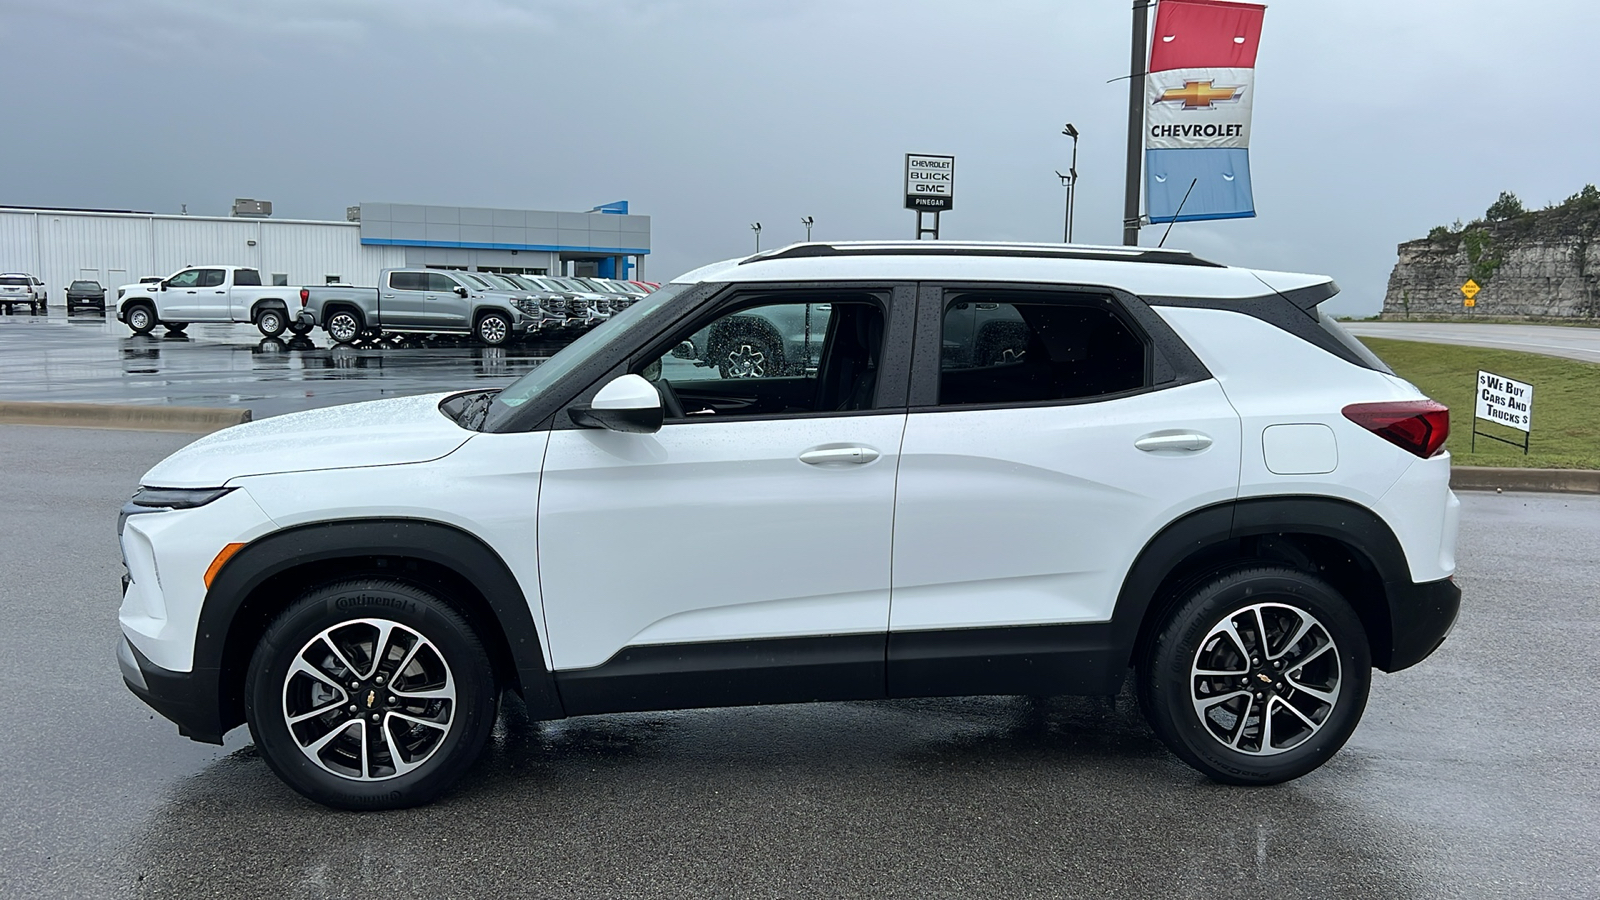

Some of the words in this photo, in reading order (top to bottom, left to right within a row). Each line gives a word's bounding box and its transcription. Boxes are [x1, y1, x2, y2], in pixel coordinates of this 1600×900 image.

[1151, 124, 1243, 137] CHEVROLET
[911, 160, 951, 169] CHEVROLET
[910, 172, 950, 181] BUICK
[915, 184, 945, 193] GMC
[915, 198, 944, 206] PINEGAR
[1481, 388, 1506, 406] CARS
[1507, 396, 1527, 412] AND
[1486, 403, 1520, 424] TRUCKS
[335, 594, 408, 611] Continental
